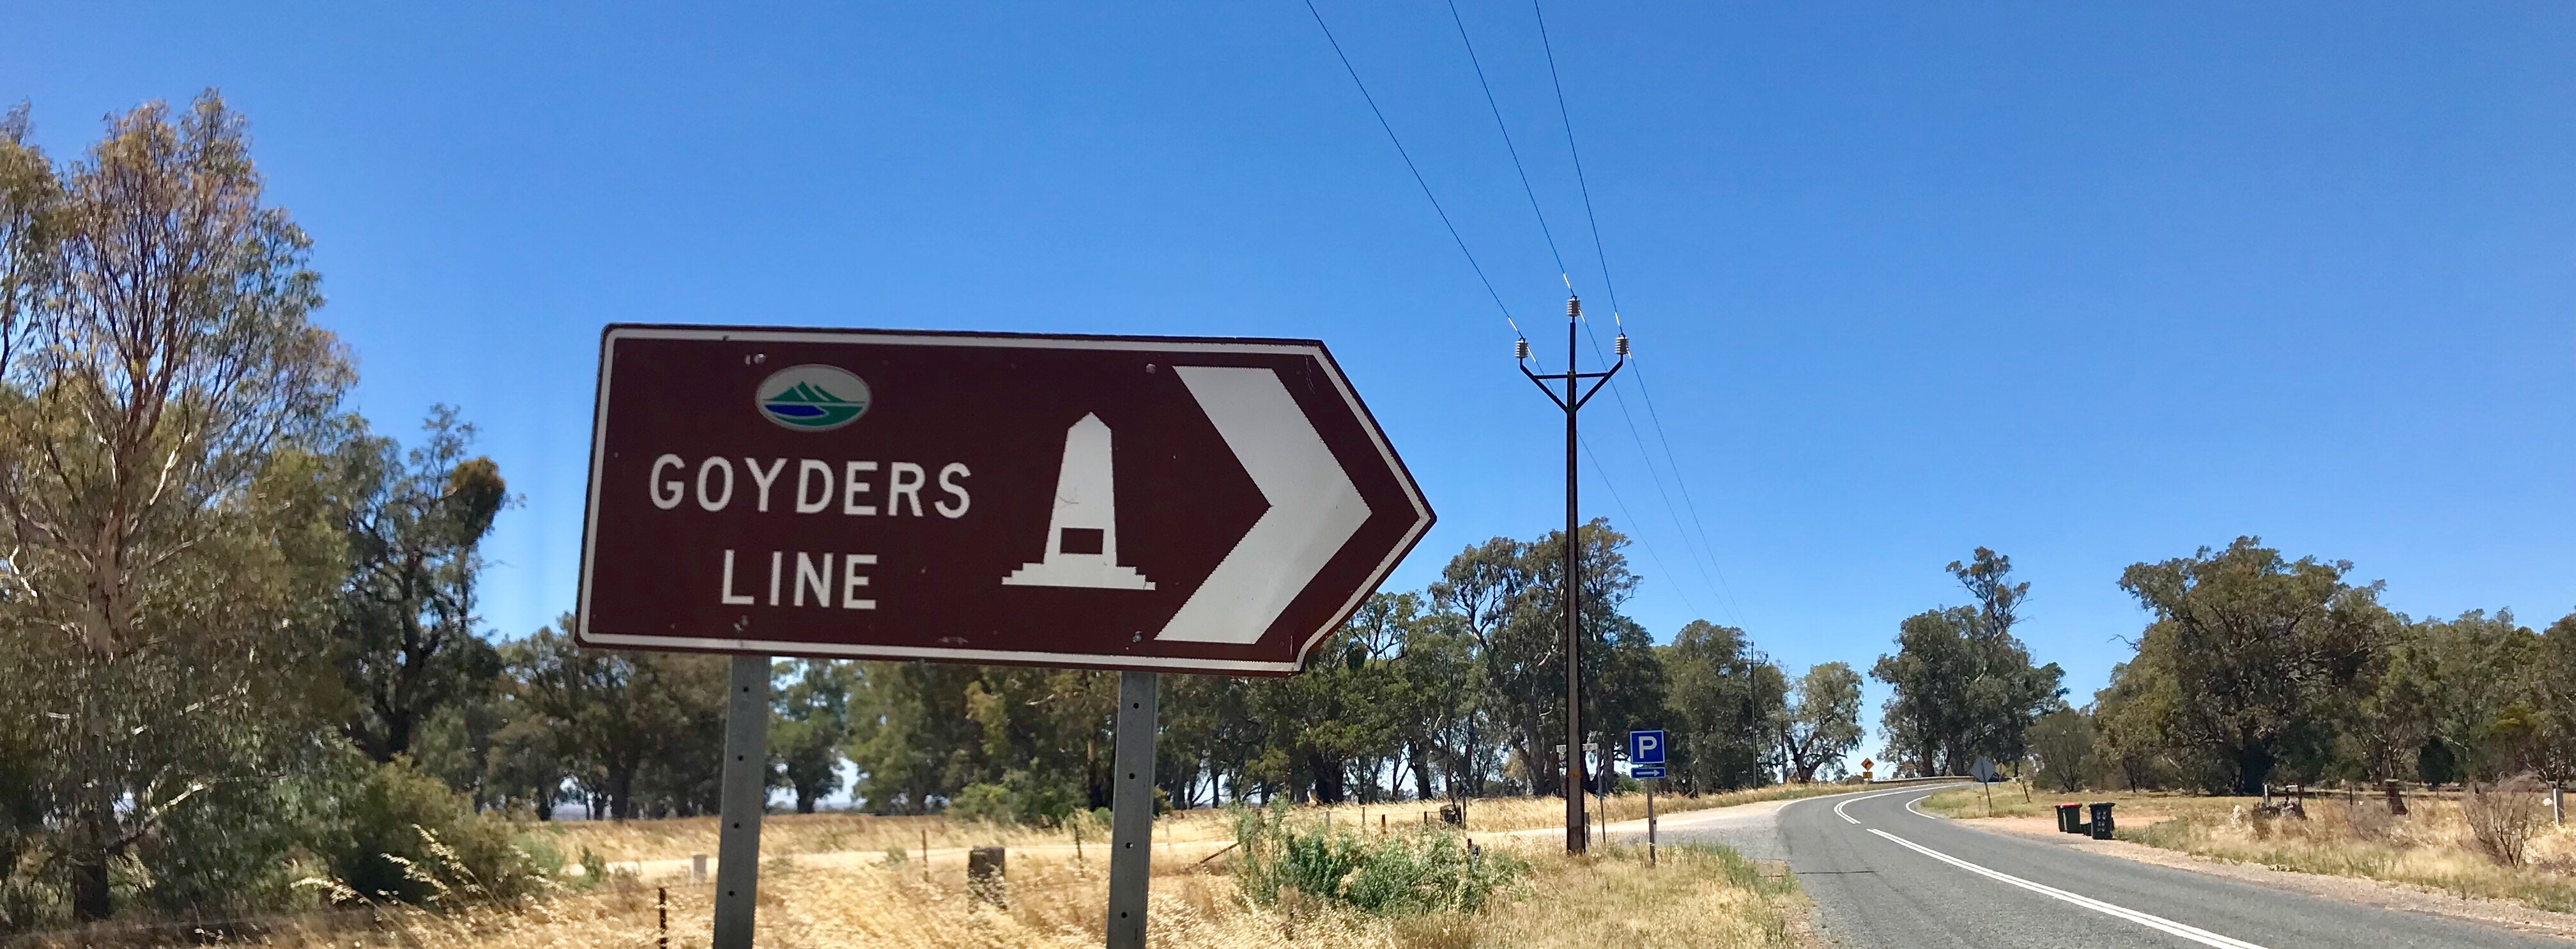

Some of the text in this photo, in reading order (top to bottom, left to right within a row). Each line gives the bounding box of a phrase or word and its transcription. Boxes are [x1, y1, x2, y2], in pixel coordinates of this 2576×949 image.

[649, 453, 972, 519] GOYDERS
[721, 549, 878, 610] LINE
[1639, 736, 1657, 759] P
